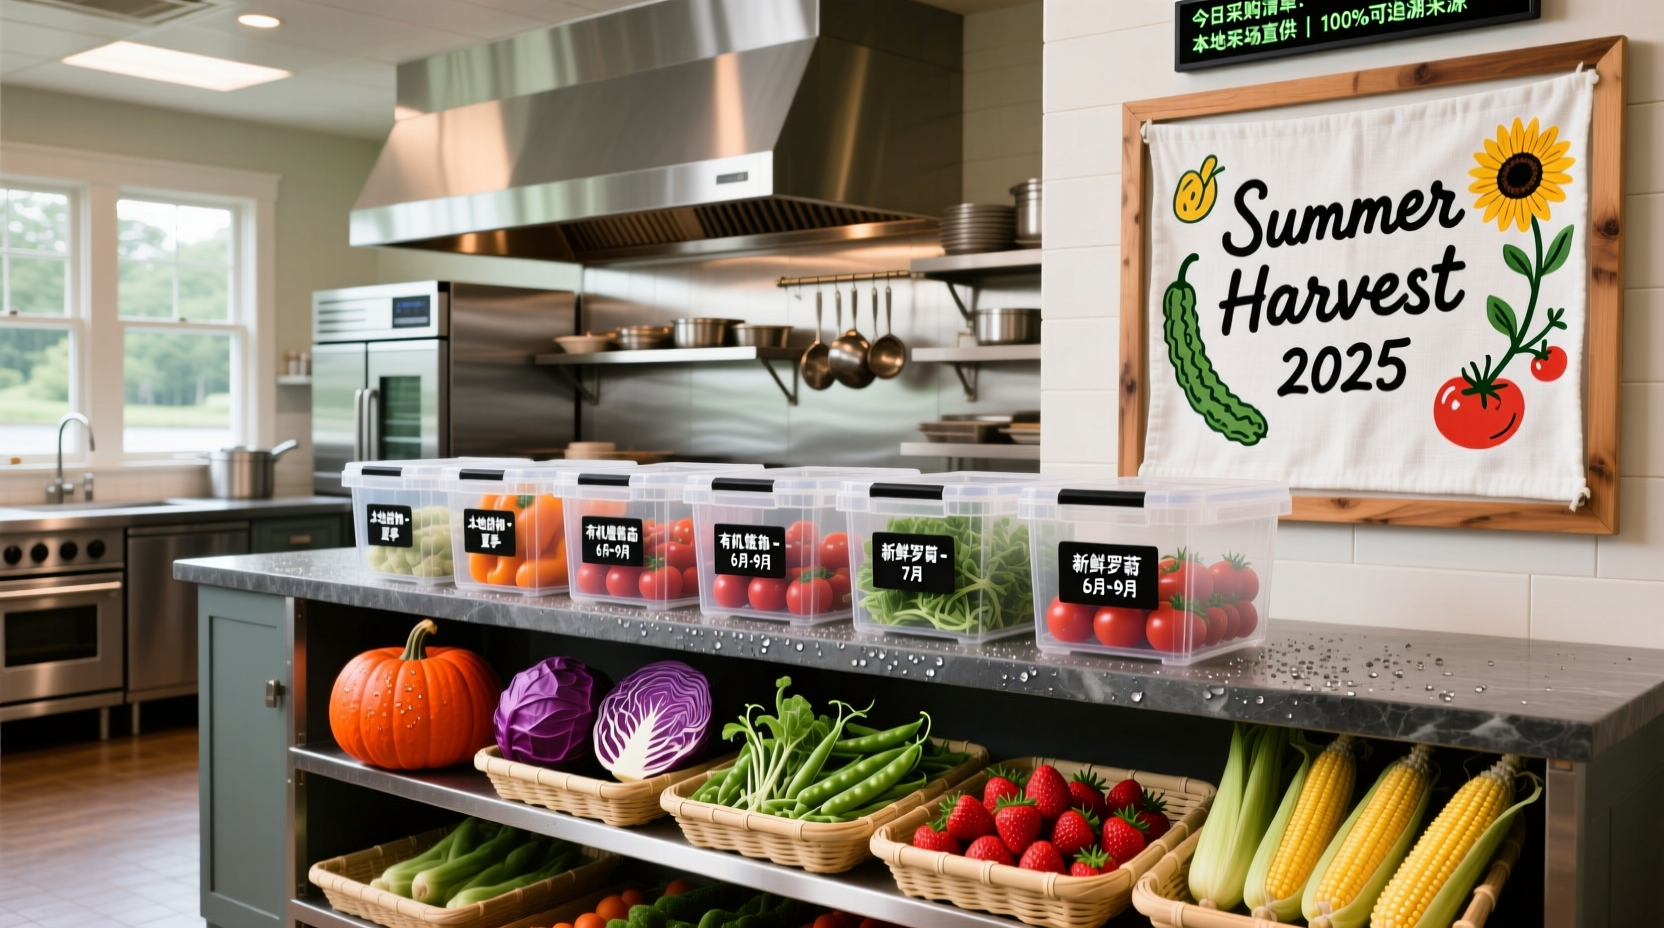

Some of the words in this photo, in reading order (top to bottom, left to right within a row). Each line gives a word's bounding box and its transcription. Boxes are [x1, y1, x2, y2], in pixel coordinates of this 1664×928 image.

[1221, 178, 1466, 258] Summer
[1218, 244, 1467, 337] Harvest
[1277, 337, 1412, 398] 2025
[730, 552, 771, 571] 6月-9月
[901, 565, 923, 583] 7月
[1082, 577, 1137, 599] 6月-9月
